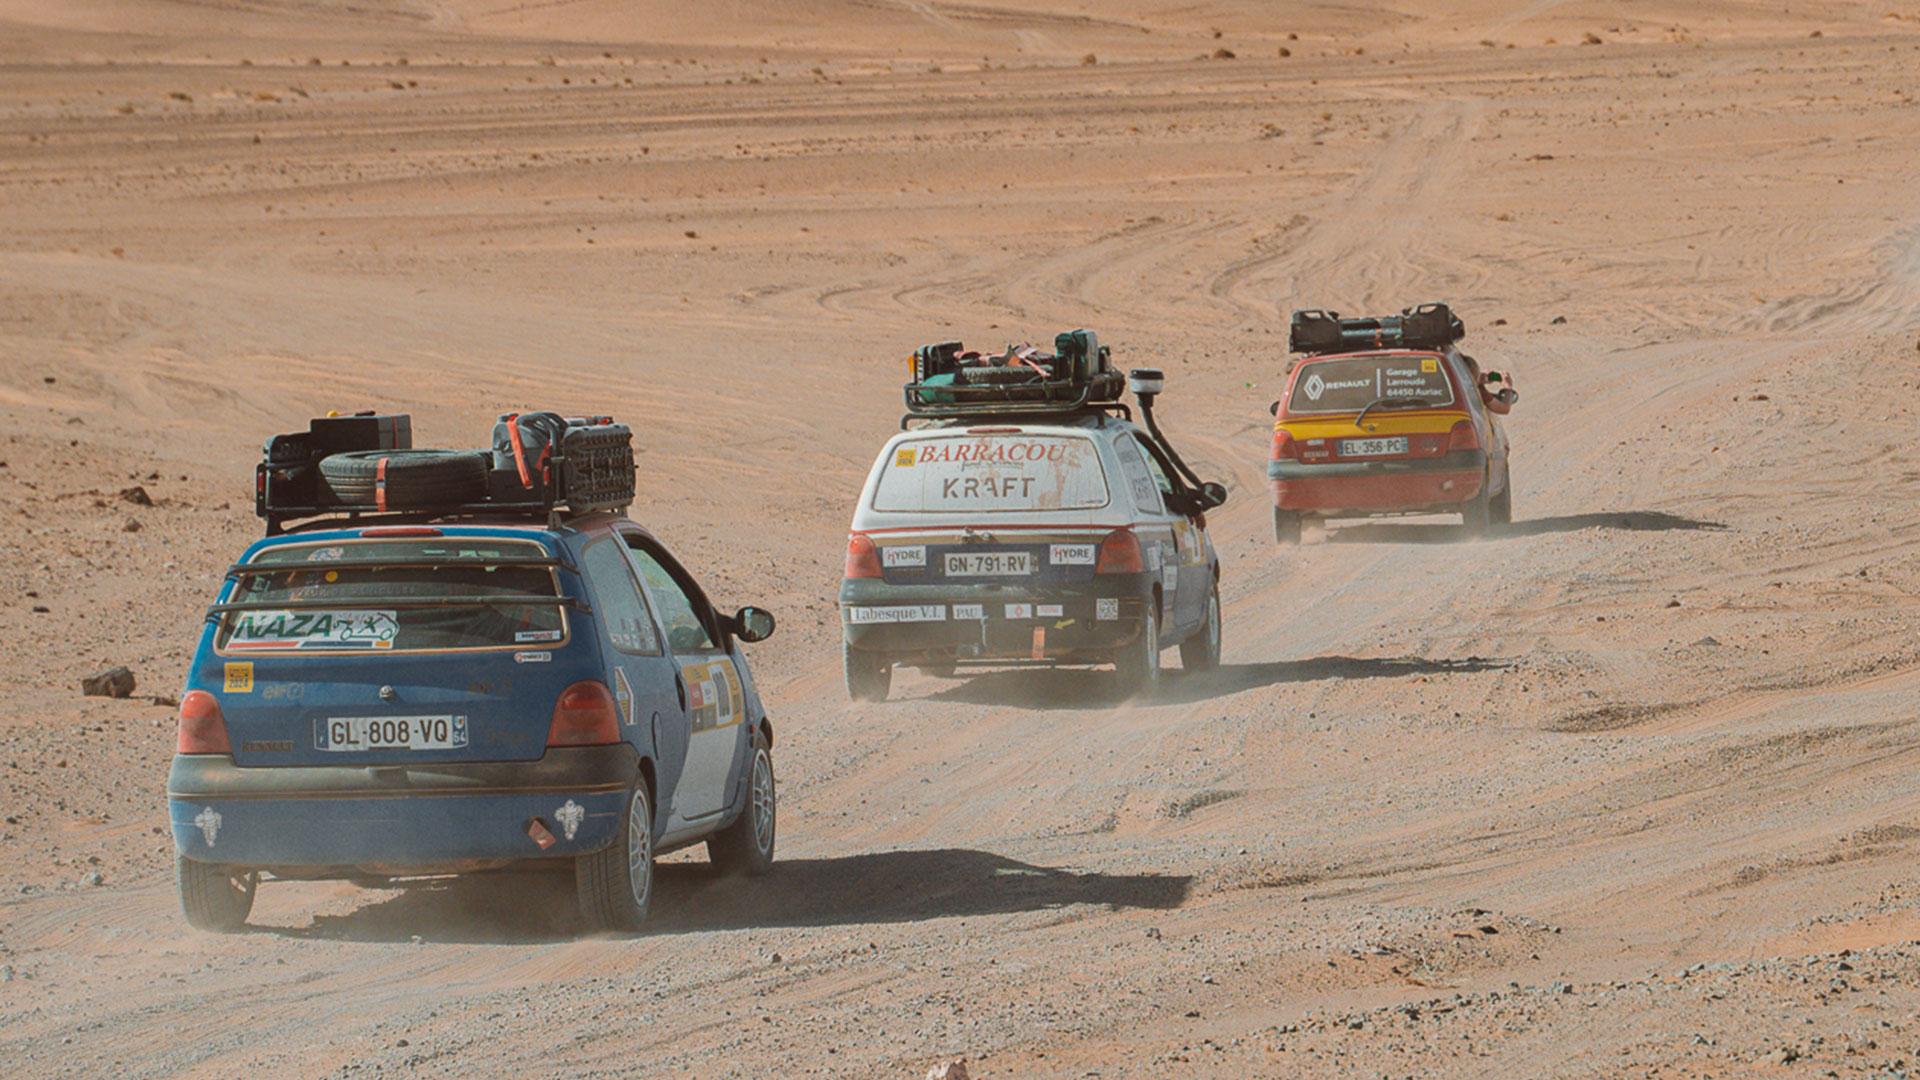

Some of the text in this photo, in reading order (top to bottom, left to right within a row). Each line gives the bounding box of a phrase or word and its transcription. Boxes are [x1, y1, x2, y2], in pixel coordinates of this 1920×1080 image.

[1386, 368, 1418, 377] Garage
[1326, 379, 1371, 390] RENAULT
[943, 477, 1036, 499] KRAFT
[887, 550, 922, 565] HYDRE
[1055, 548, 1090, 562] HYDRE
[949, 555, 1026, 573] GN-791-RV
[855, 607, 917, 622] Labesque
[234, 614, 333, 639] NAZA
[332, 719, 448, 746] GL-808-VQ
